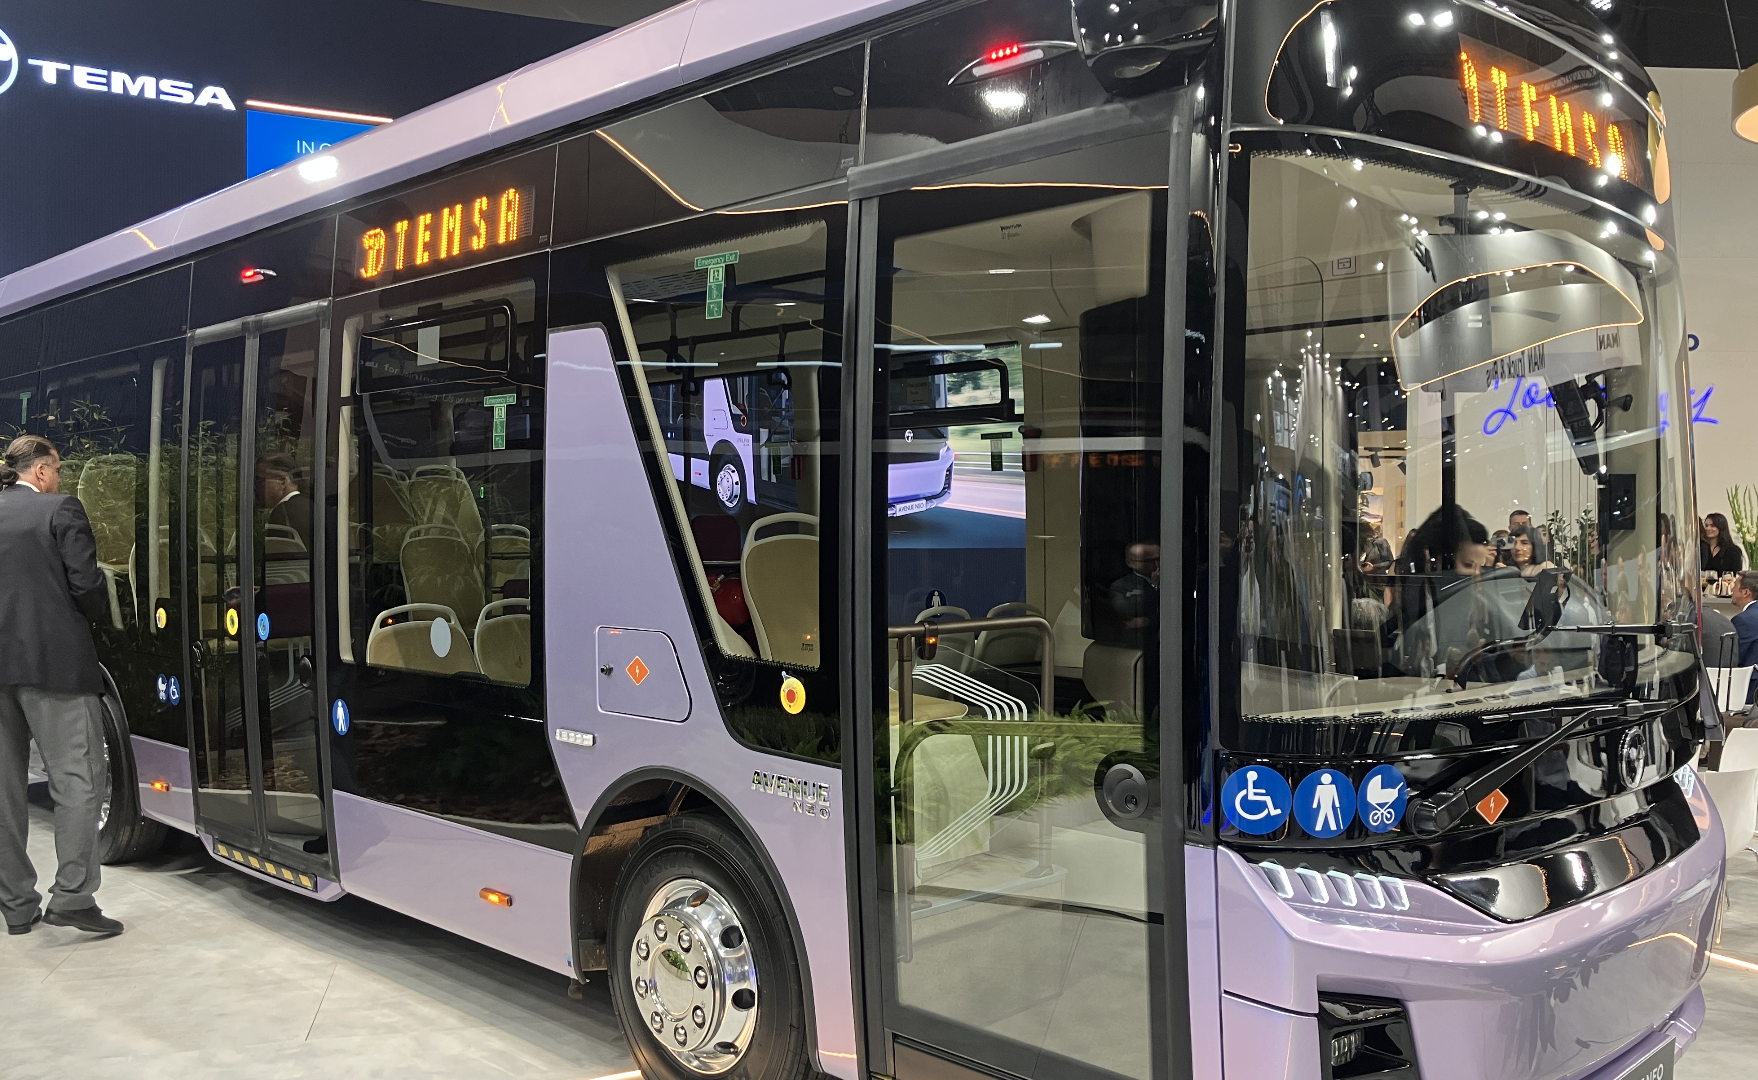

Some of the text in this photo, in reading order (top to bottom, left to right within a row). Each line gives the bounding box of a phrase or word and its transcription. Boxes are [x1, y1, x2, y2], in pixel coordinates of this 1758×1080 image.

[27, 57, 237, 111] TEMSA
[297, 139, 315, 154] IN
[395, 187, 521, 271] TEMSA
[752, 770, 831, 806] AVENUE
[793, 800, 831, 820] NEO
